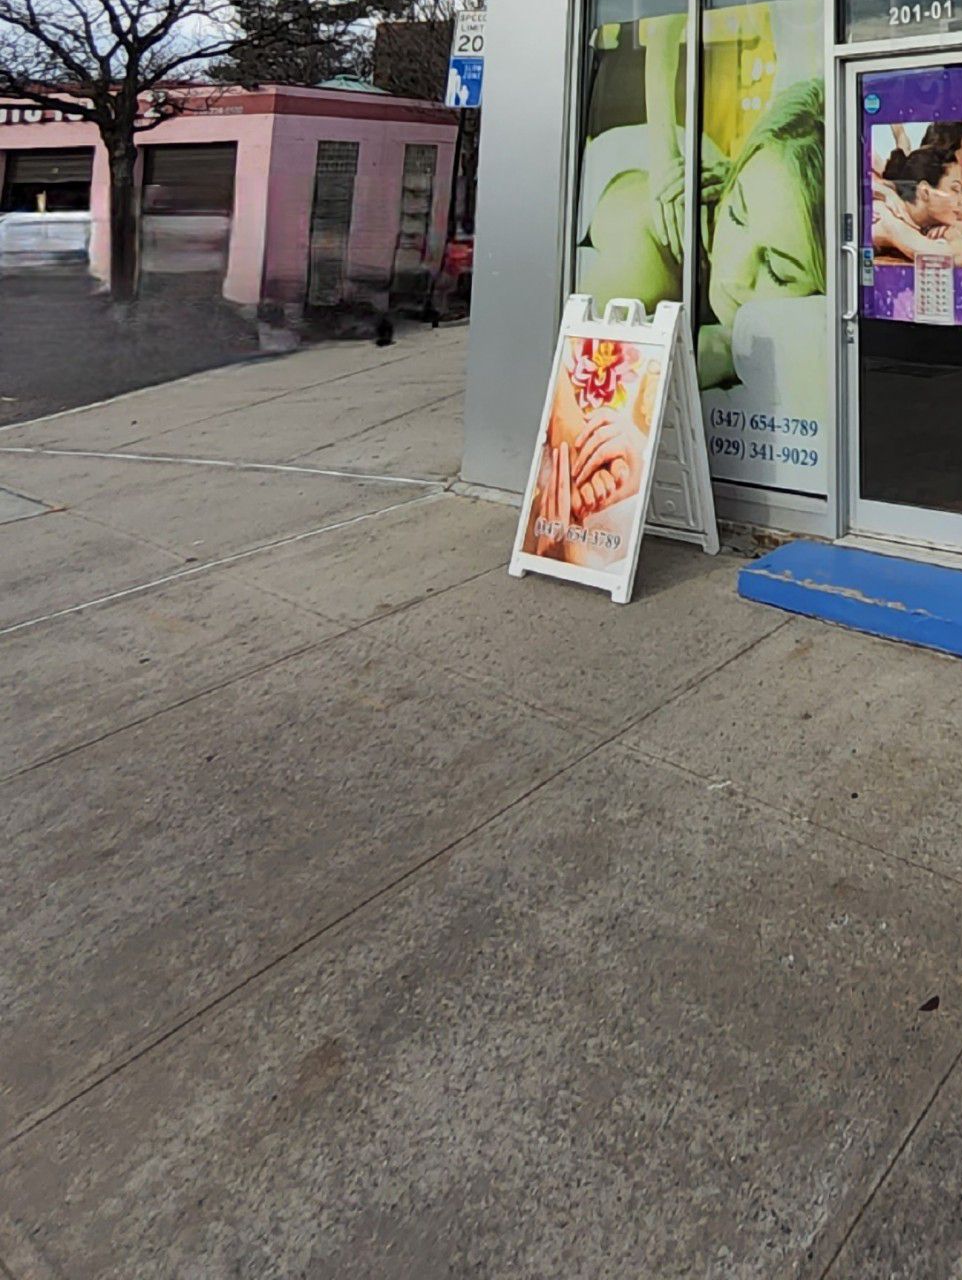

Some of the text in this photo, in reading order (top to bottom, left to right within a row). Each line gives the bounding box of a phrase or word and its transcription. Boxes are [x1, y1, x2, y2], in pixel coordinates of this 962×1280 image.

[889, 0, 952, 25] 201-01
[458, 35, 484, 52] 20
[711, 408, 818, 436] (347) 654-3789
[710, 435, 818, 466] (929) 341-9029
